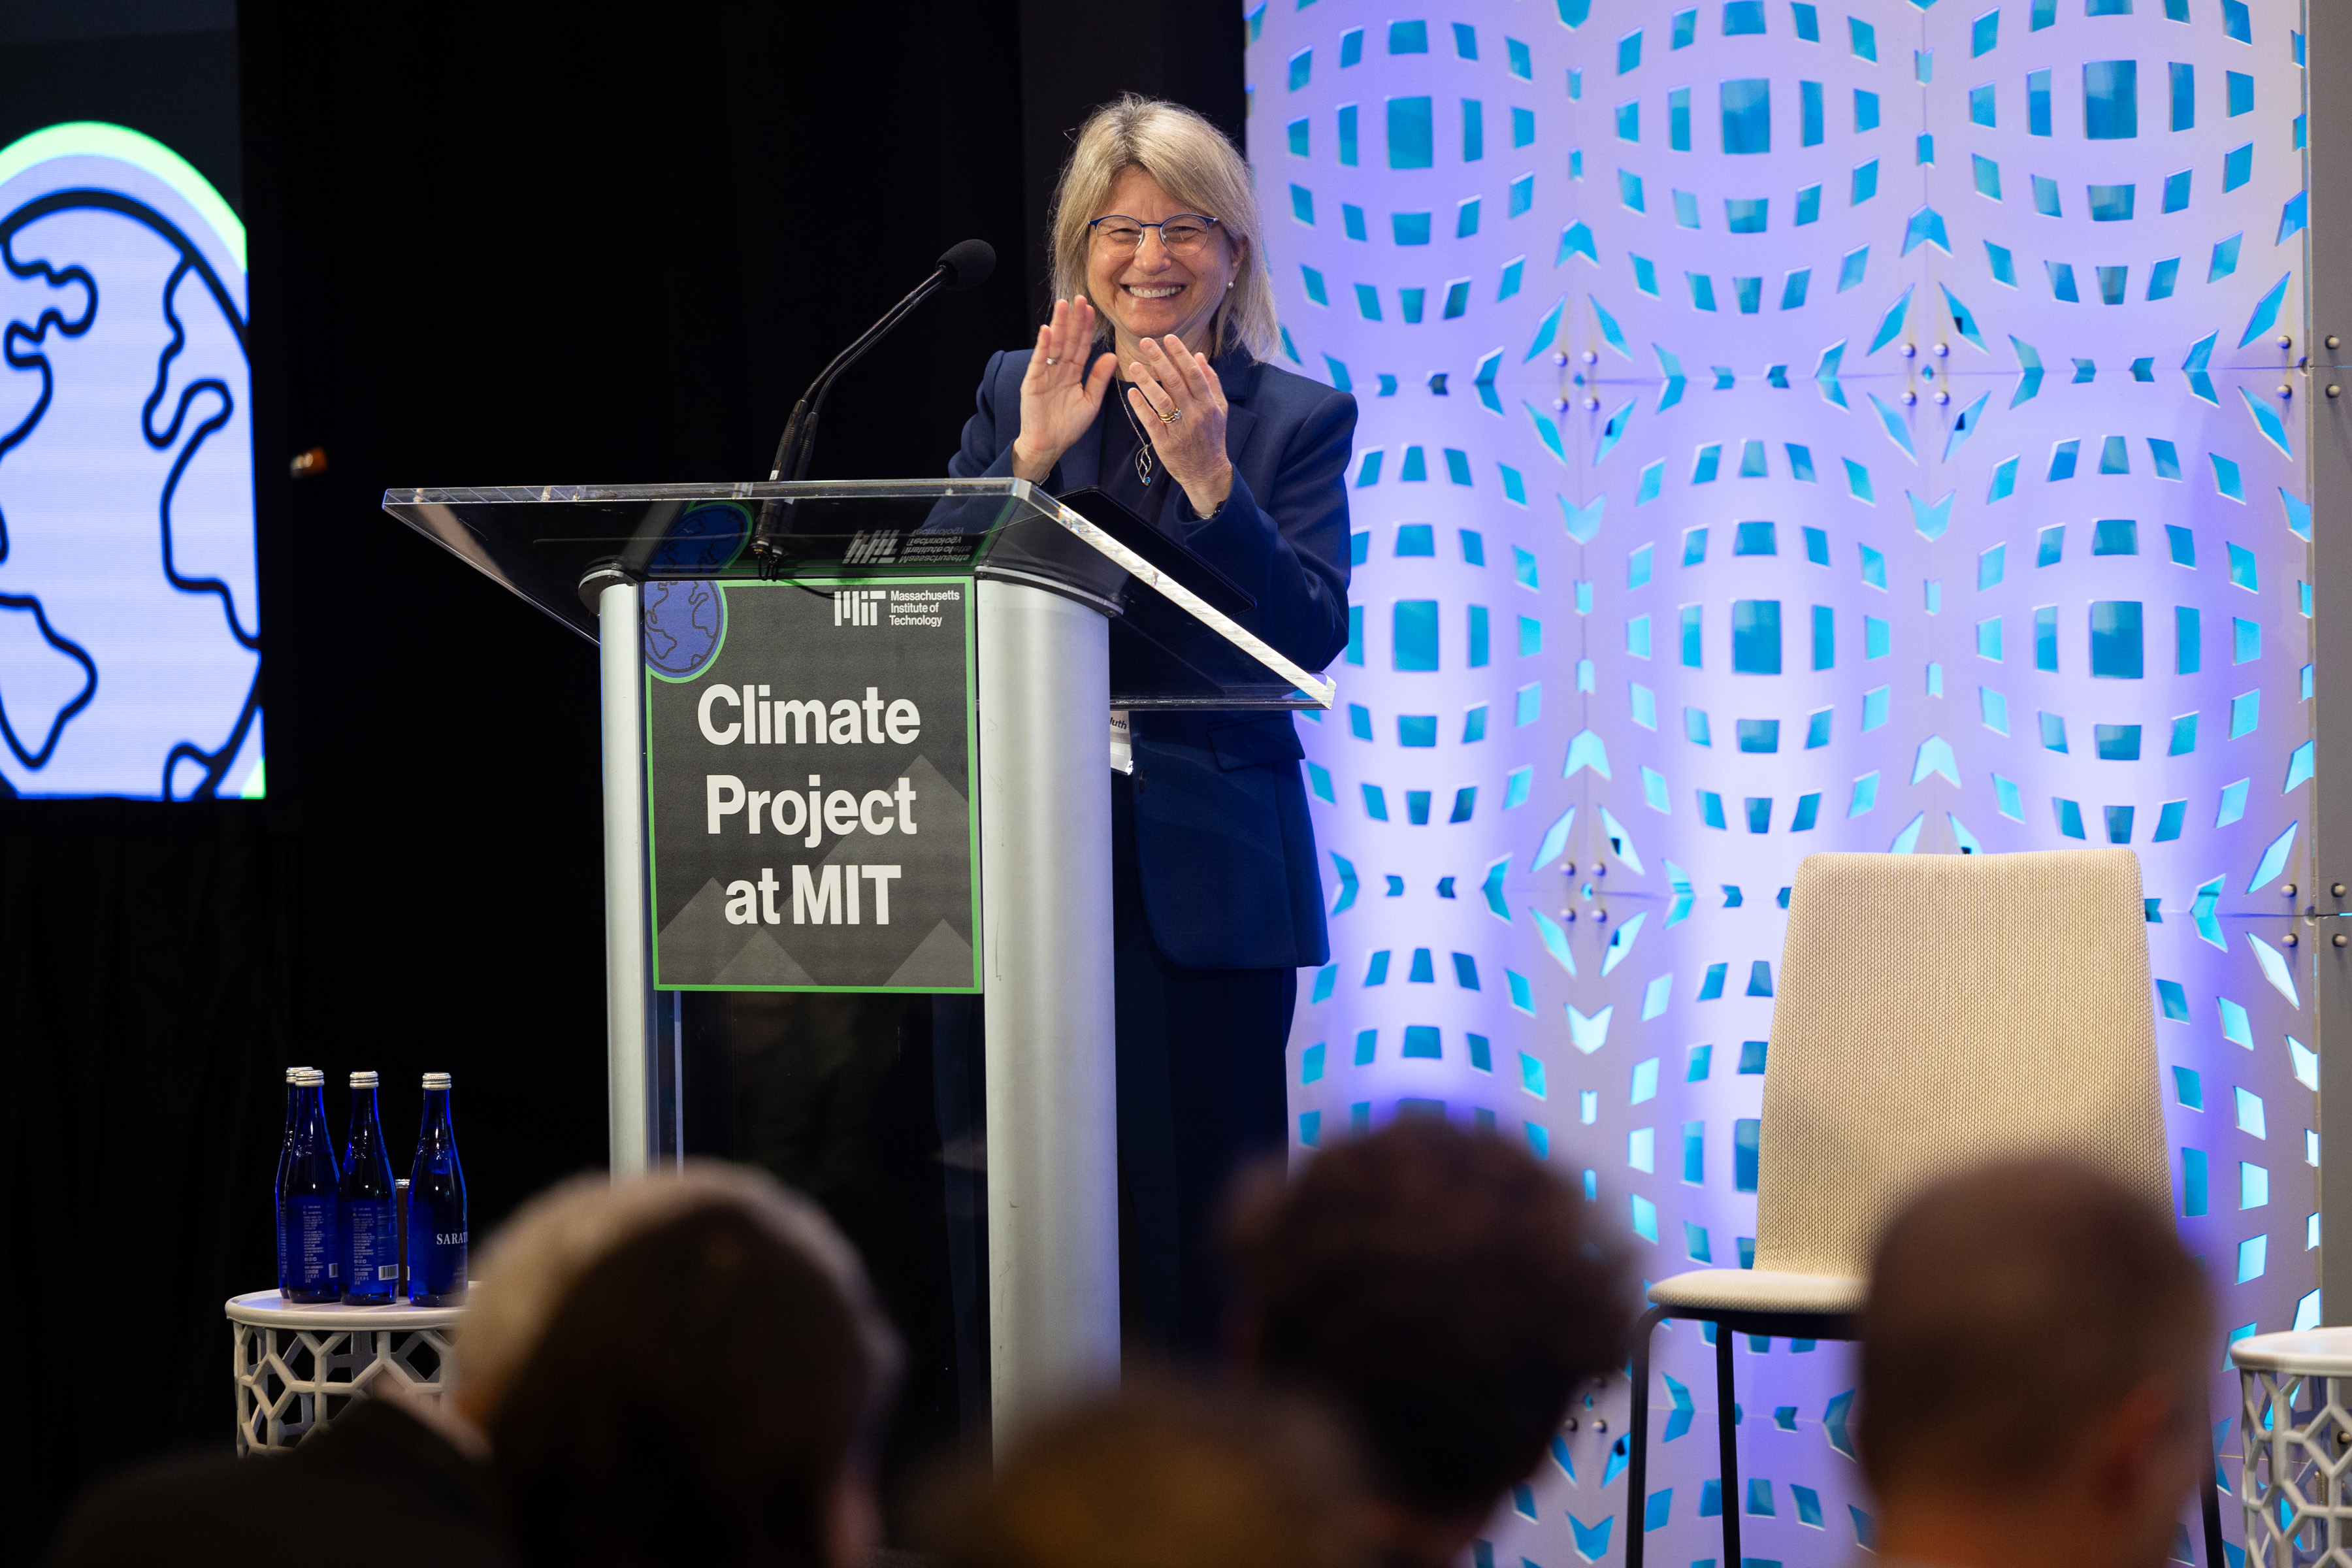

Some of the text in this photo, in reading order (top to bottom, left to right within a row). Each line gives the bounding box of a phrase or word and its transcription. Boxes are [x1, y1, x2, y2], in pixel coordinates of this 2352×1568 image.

[890, 590, 960, 601] Massachusetts
[890, 602, 939, 613] Institute of
[889, 615, 943, 627] Technology
[697, 683, 921, 745] Climate
[706, 774, 917, 849] Project
[725, 864, 902, 925] at MIT
